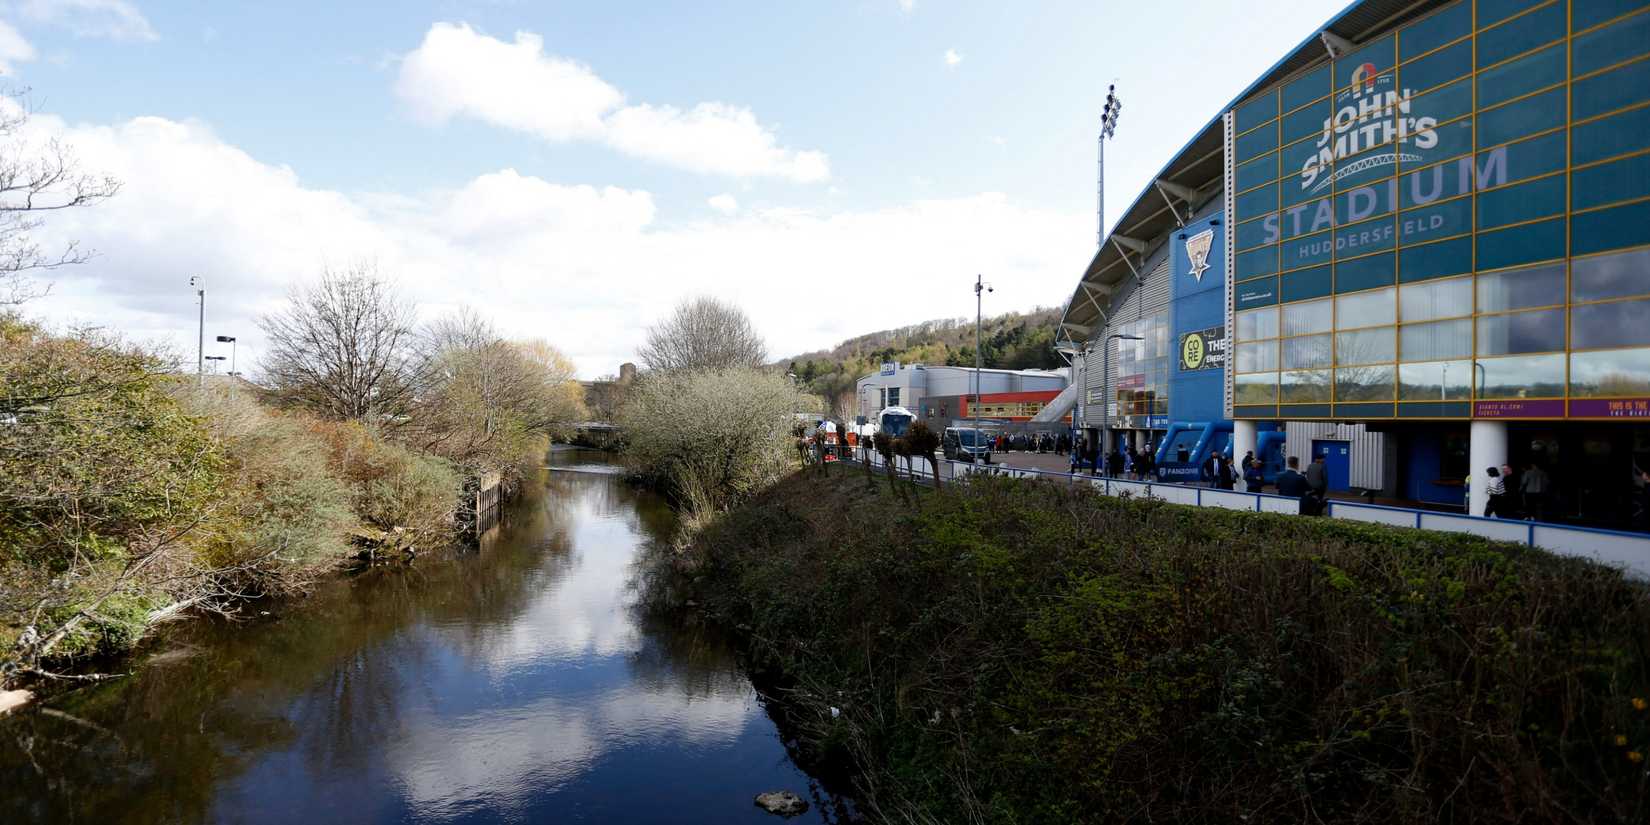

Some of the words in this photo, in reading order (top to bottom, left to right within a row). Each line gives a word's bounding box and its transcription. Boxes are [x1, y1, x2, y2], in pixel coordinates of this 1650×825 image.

[1316, 88, 1412, 148] JOHN
[1301, 116, 1439, 190] SMITH'S
[1263, 146, 1508, 244] STADIUM
[1298, 215, 1444, 259] HUDDERSFELD
[1207, 338, 1226, 352] THE
